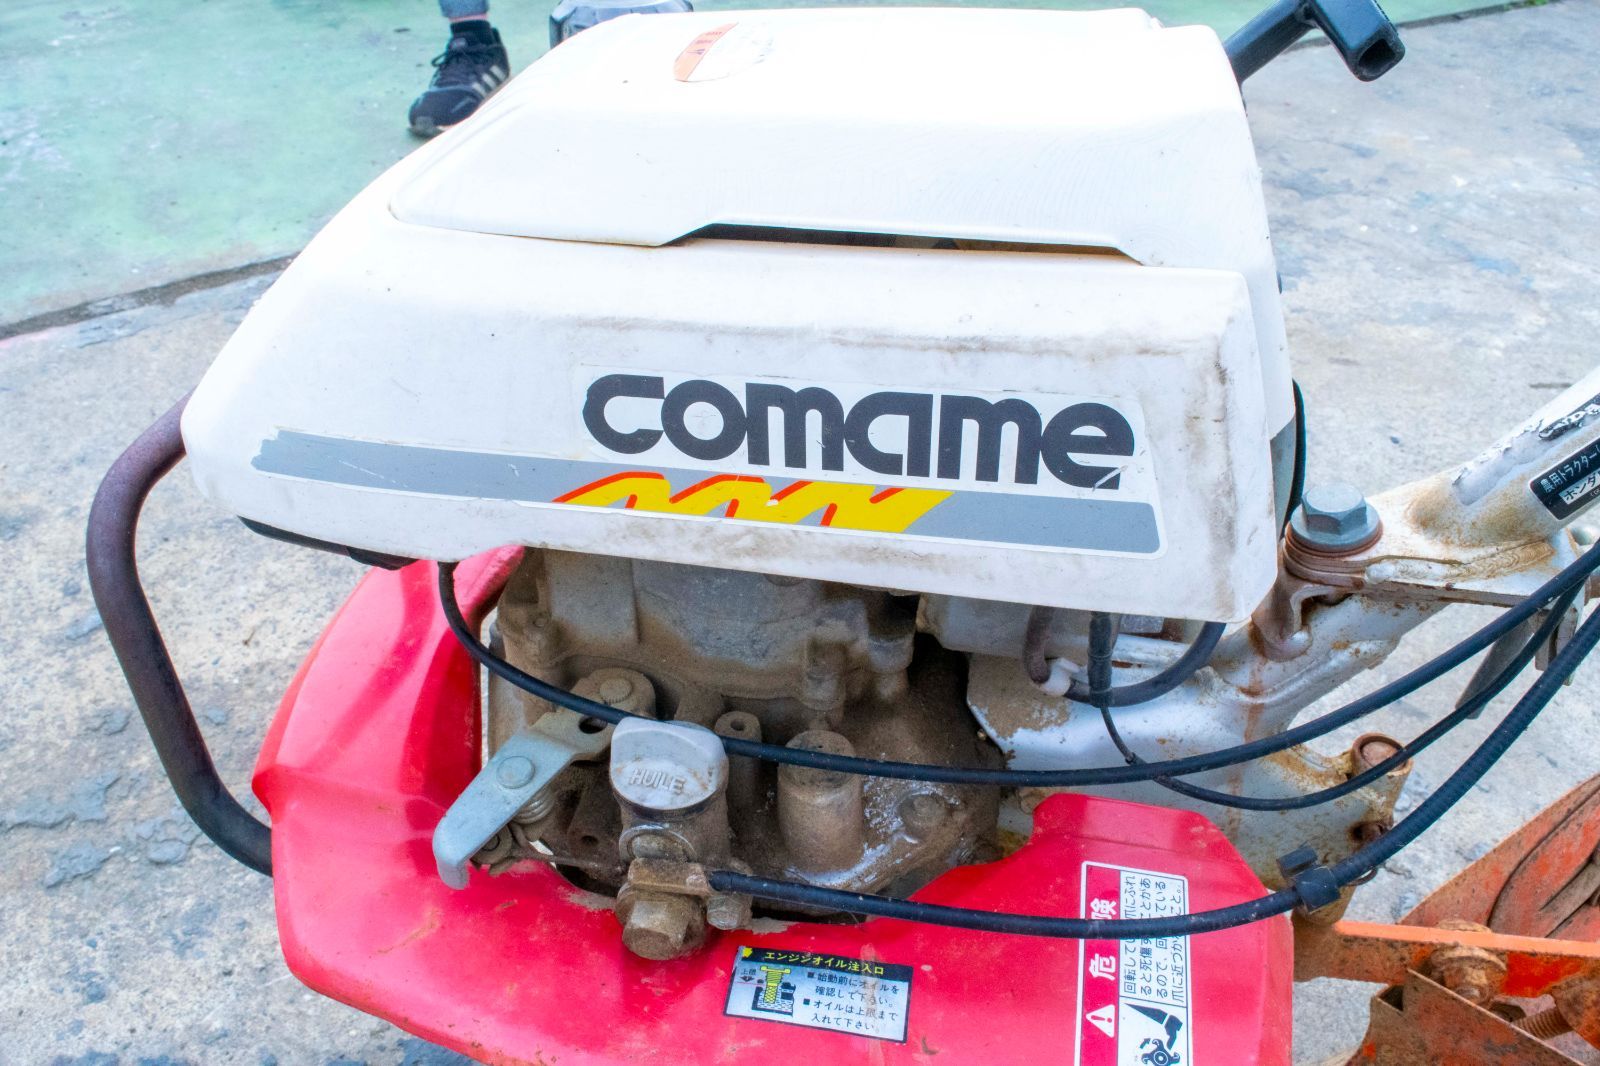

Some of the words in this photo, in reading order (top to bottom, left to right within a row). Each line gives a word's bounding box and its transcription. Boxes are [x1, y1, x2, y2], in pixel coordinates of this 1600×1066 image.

[583, 372, 1134, 491] comame
[1564, 470, 1600, 501] ホンダ
[629, 767, 687, 796] HUILE
[813, 999, 898, 1021] オイルは上限まで
